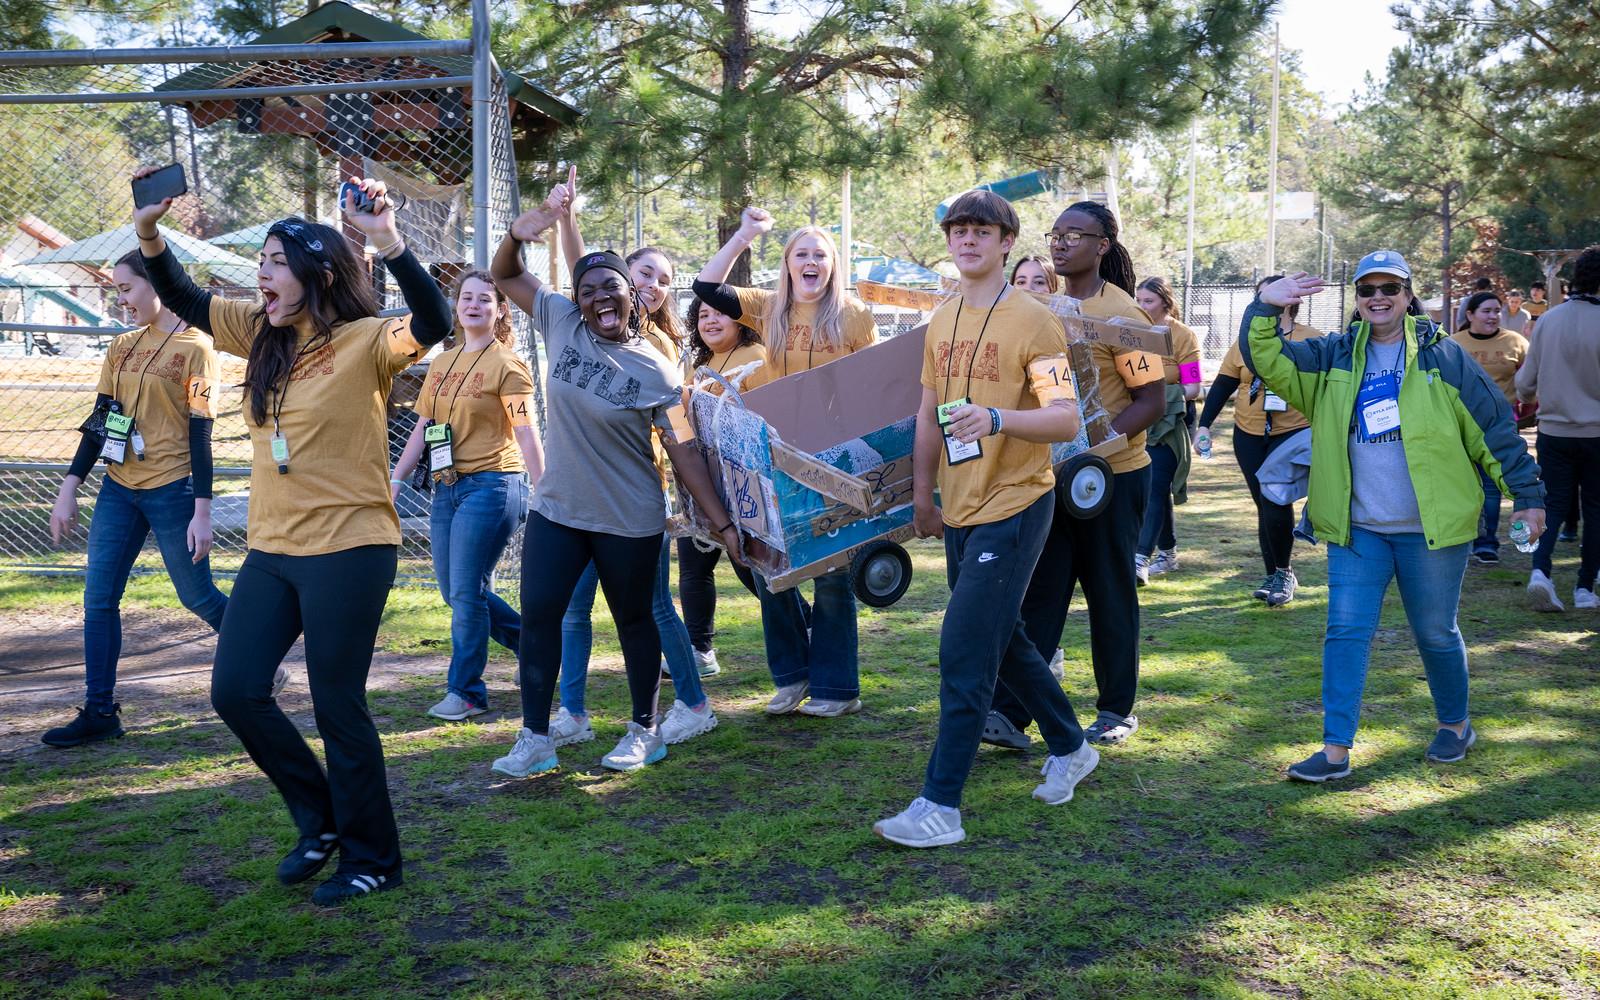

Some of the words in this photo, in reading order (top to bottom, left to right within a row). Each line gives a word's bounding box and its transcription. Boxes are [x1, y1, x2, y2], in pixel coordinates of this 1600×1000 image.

[114, 347, 185, 384] RYLA
[936, 339, 1001, 383] RYLA
[1125, 354, 1150, 377] 14
[430, 371, 484, 399] RYLA
[552, 344, 643, 410] RYLA
[1048, 365, 1073, 387] 14
[191, 381, 212, 402] 14
[506, 400, 528, 418] 14
[114, 416, 126, 426] RYLA
